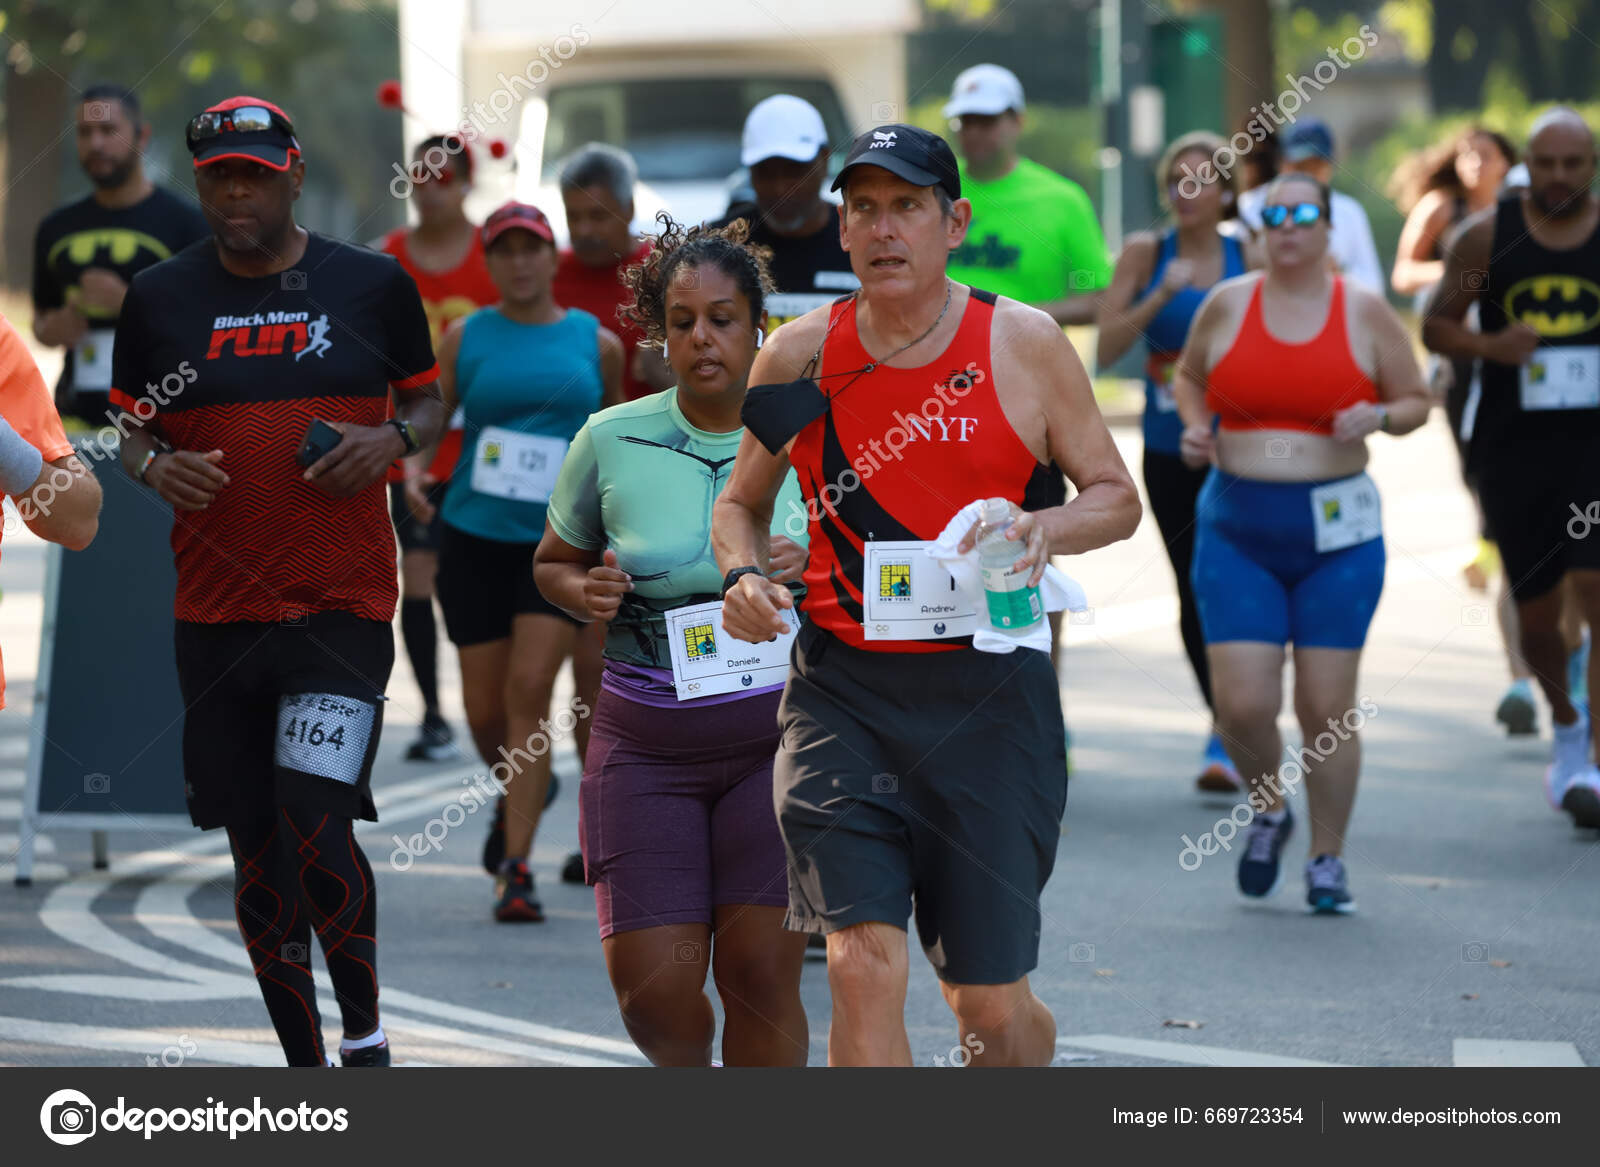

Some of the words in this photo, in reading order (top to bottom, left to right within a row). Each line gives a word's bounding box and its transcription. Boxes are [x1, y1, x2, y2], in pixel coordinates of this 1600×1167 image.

[869, 141, 896, 149] NYF
[213, 313, 265, 329] Black
[266, 311, 309, 324] Men
[206, 321, 308, 360] run
[907, 417, 979, 442] NYF
[891, 565, 910, 575] RUN
[921, 605, 956, 613] Andrew
[694, 624, 713, 636] RUN
[727, 656, 761, 668] Danielle
[285, 716, 345, 751] 4164
